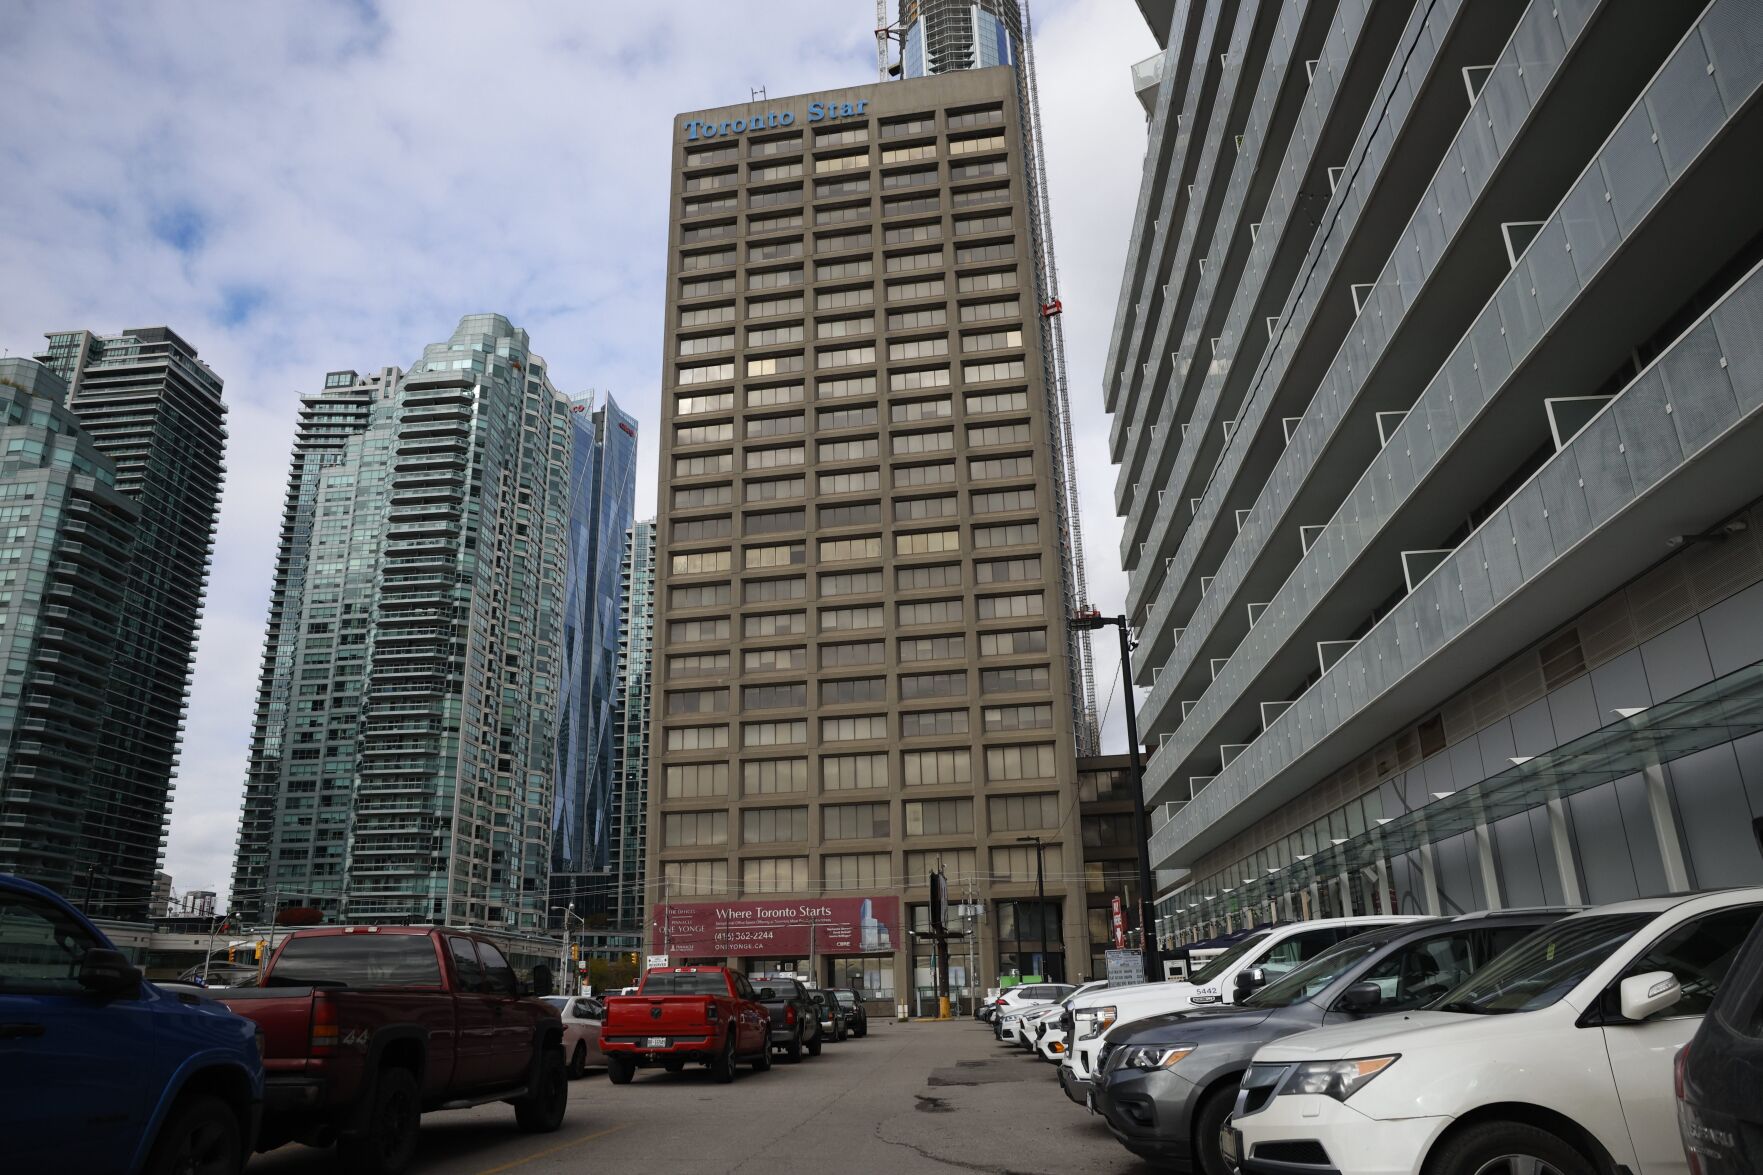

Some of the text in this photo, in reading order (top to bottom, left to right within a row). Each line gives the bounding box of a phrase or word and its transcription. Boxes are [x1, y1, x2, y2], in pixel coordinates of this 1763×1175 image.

[684, 99, 869, 141] Toronto Star
[716, 905, 832, 919] Where Toronto Starts
[735, 931, 774, 940] 362-2244
[1196, 987, 1218, 995] 5442
